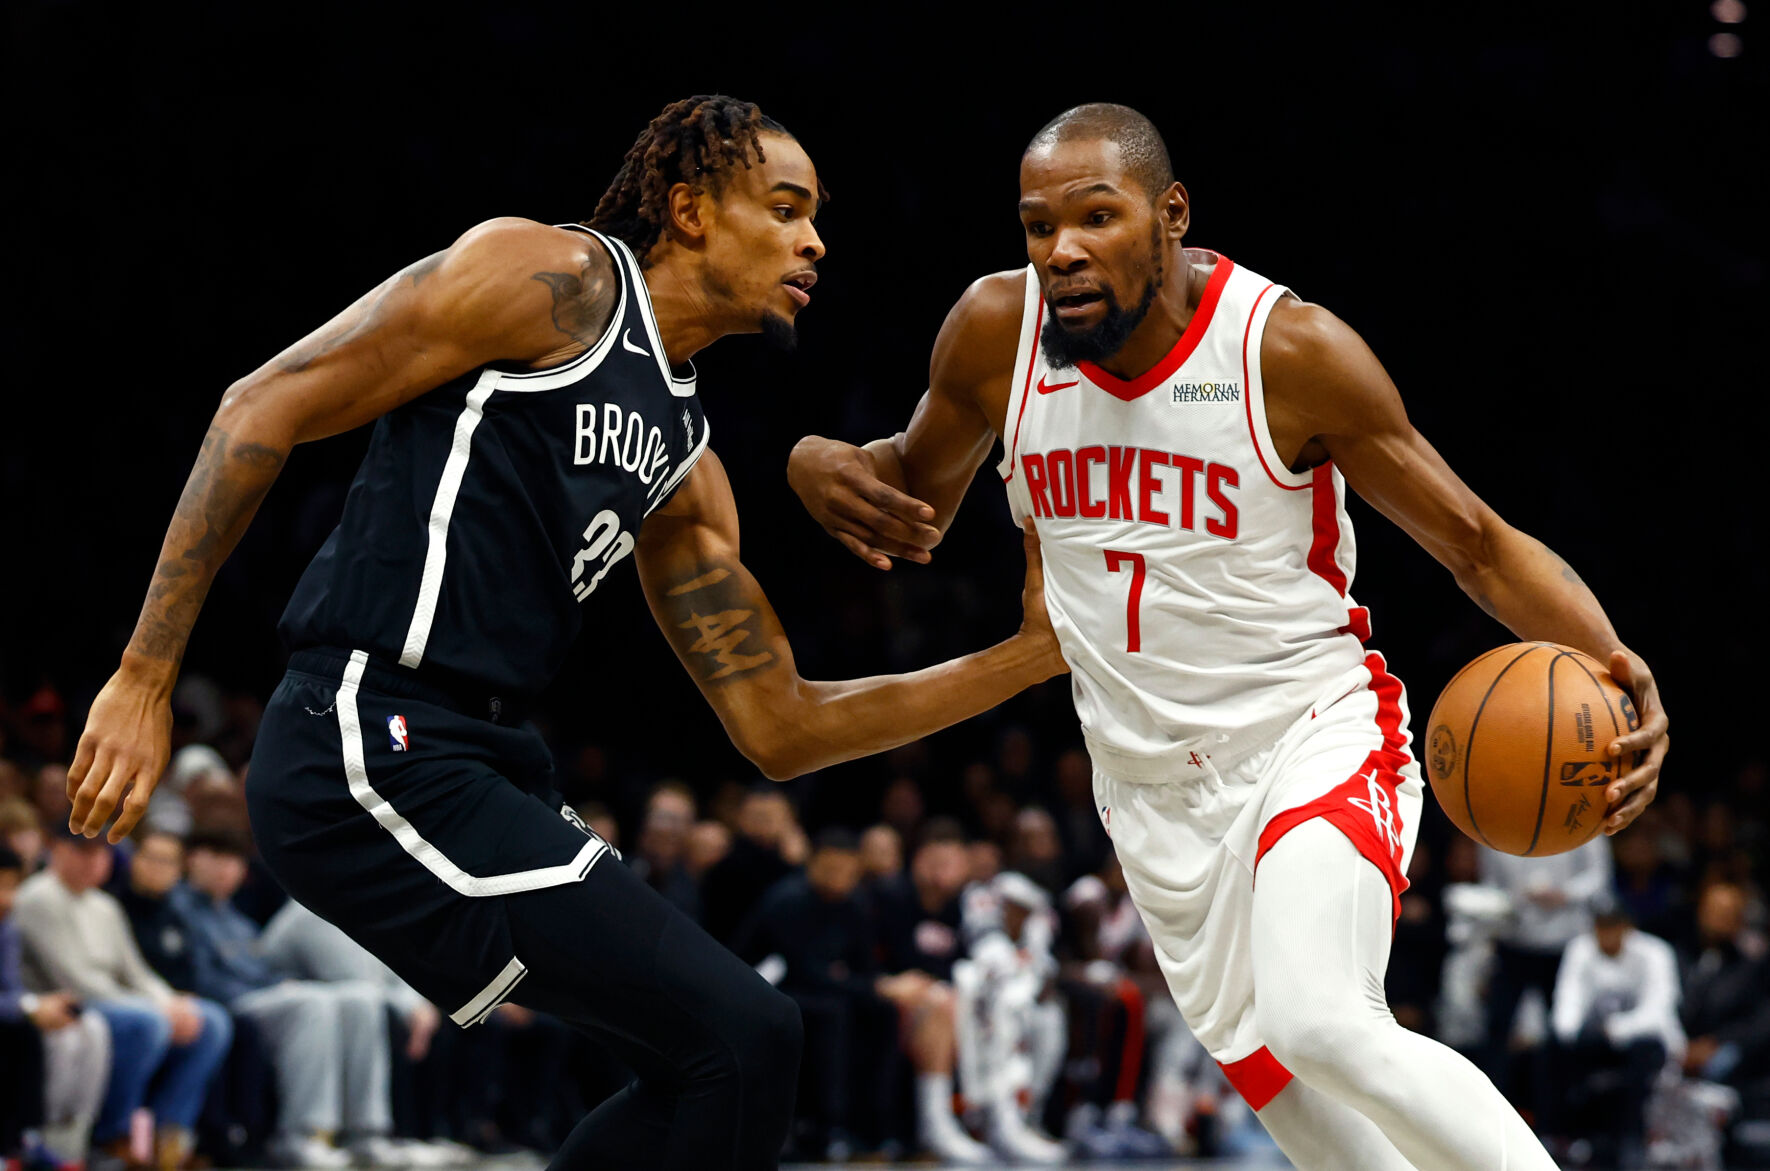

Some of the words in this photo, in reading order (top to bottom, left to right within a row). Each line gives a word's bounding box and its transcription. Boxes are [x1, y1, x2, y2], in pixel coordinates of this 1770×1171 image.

[1173, 383, 1239, 394] MEMORIAL
[1173, 392, 1239, 402] HERMANN
[1021, 445, 1240, 541] ROCKETS
[1103, 549, 1146, 653] 7
